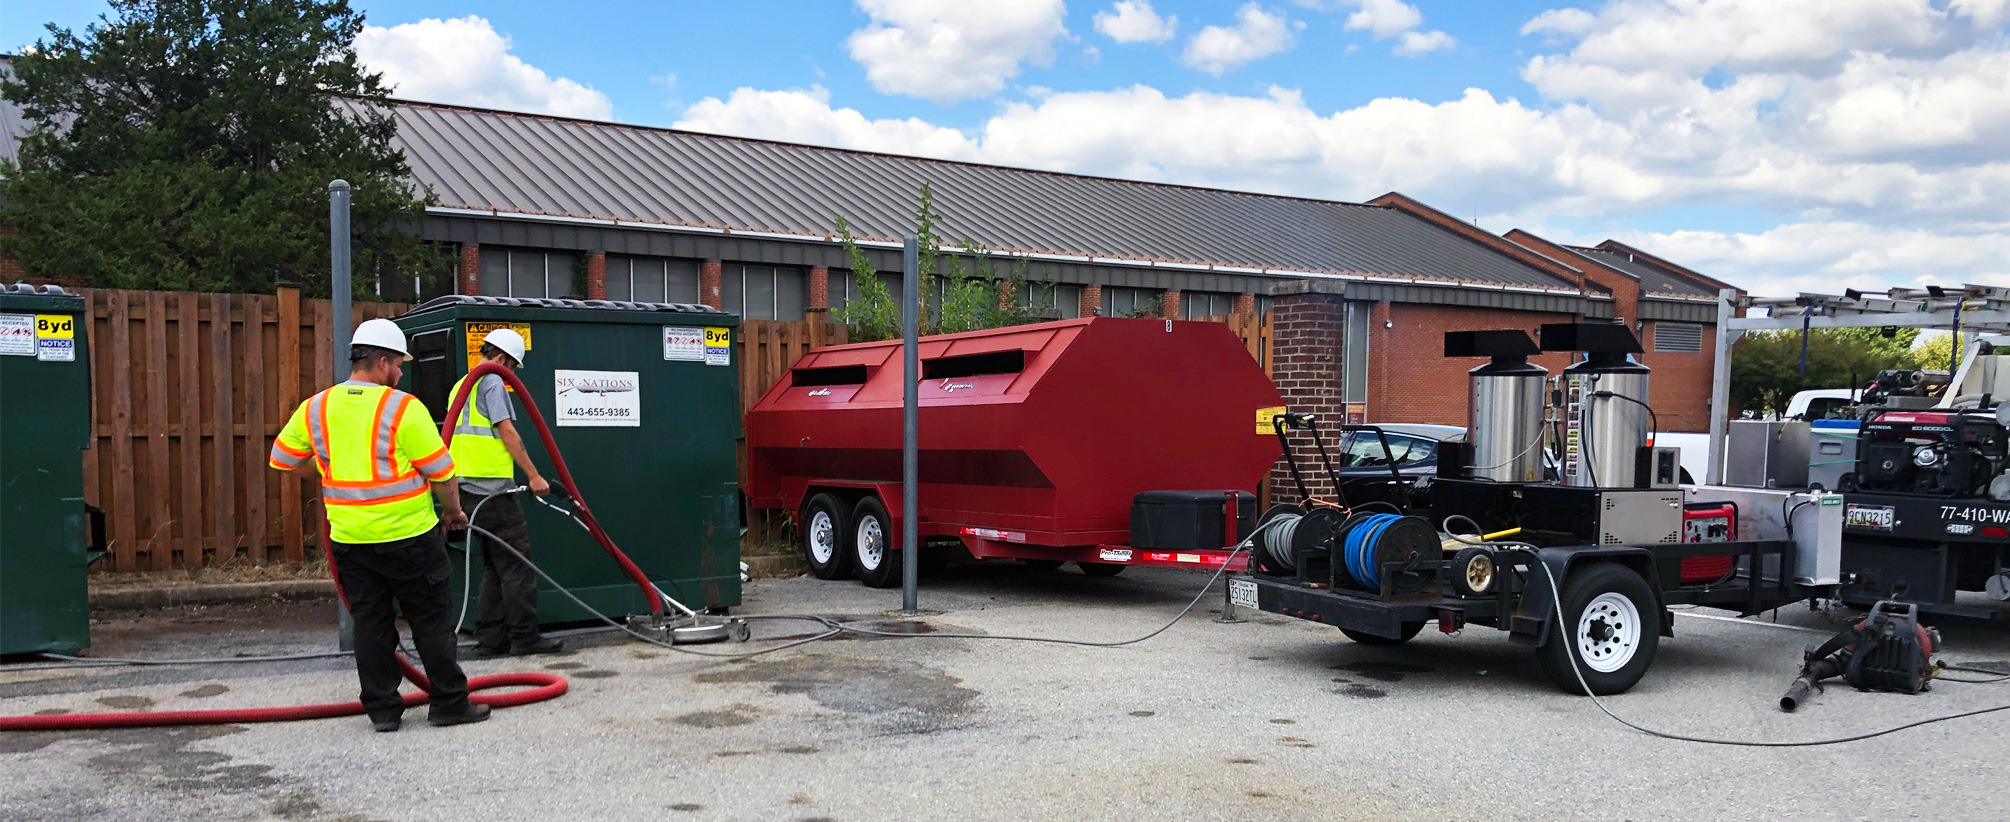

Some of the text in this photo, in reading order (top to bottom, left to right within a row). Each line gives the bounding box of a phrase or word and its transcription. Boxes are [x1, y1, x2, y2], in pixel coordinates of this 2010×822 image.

[38, 319, 72, 333] 8yd
[478, 324, 508, 332] CAUTION
[706, 330, 729, 342] 8yd
[557, 378, 633, 388] SIX NATIONS
[567, 407, 630, 417] 443-655-9385
